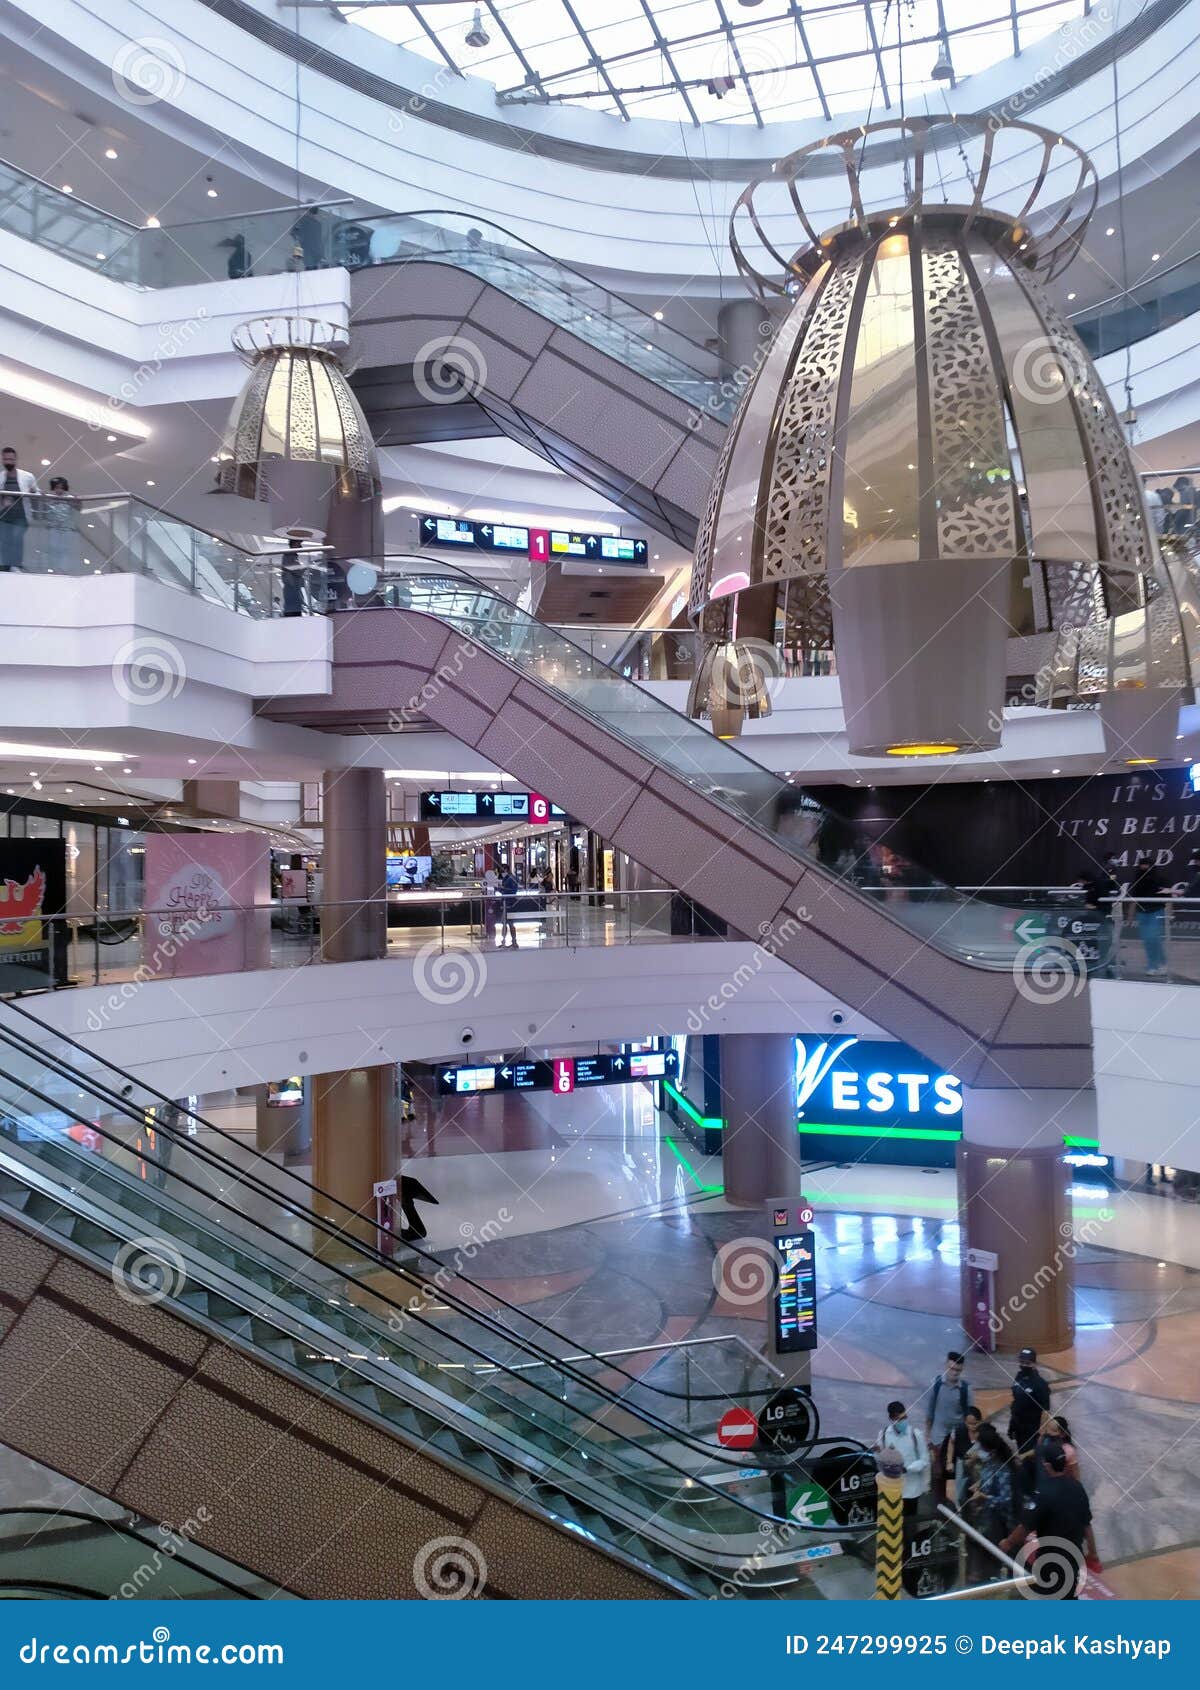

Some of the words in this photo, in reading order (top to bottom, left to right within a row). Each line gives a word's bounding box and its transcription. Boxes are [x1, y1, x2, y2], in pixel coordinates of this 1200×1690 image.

[536, 536, 545, 553] 1
[1112, 783, 1166, 803] IT'S
[533, 799, 546, 817] G
[1057, 818, 1109, 837] IT'S
[1122, 814, 1200, 835] BEAU
[1117, 849, 1174, 867] AND
[778, 1237, 793, 1250] LG
[766, 1406, 784, 1421] LG
[840, 1475, 860, 1492] LG
[911, 1538, 931, 1557] LG
